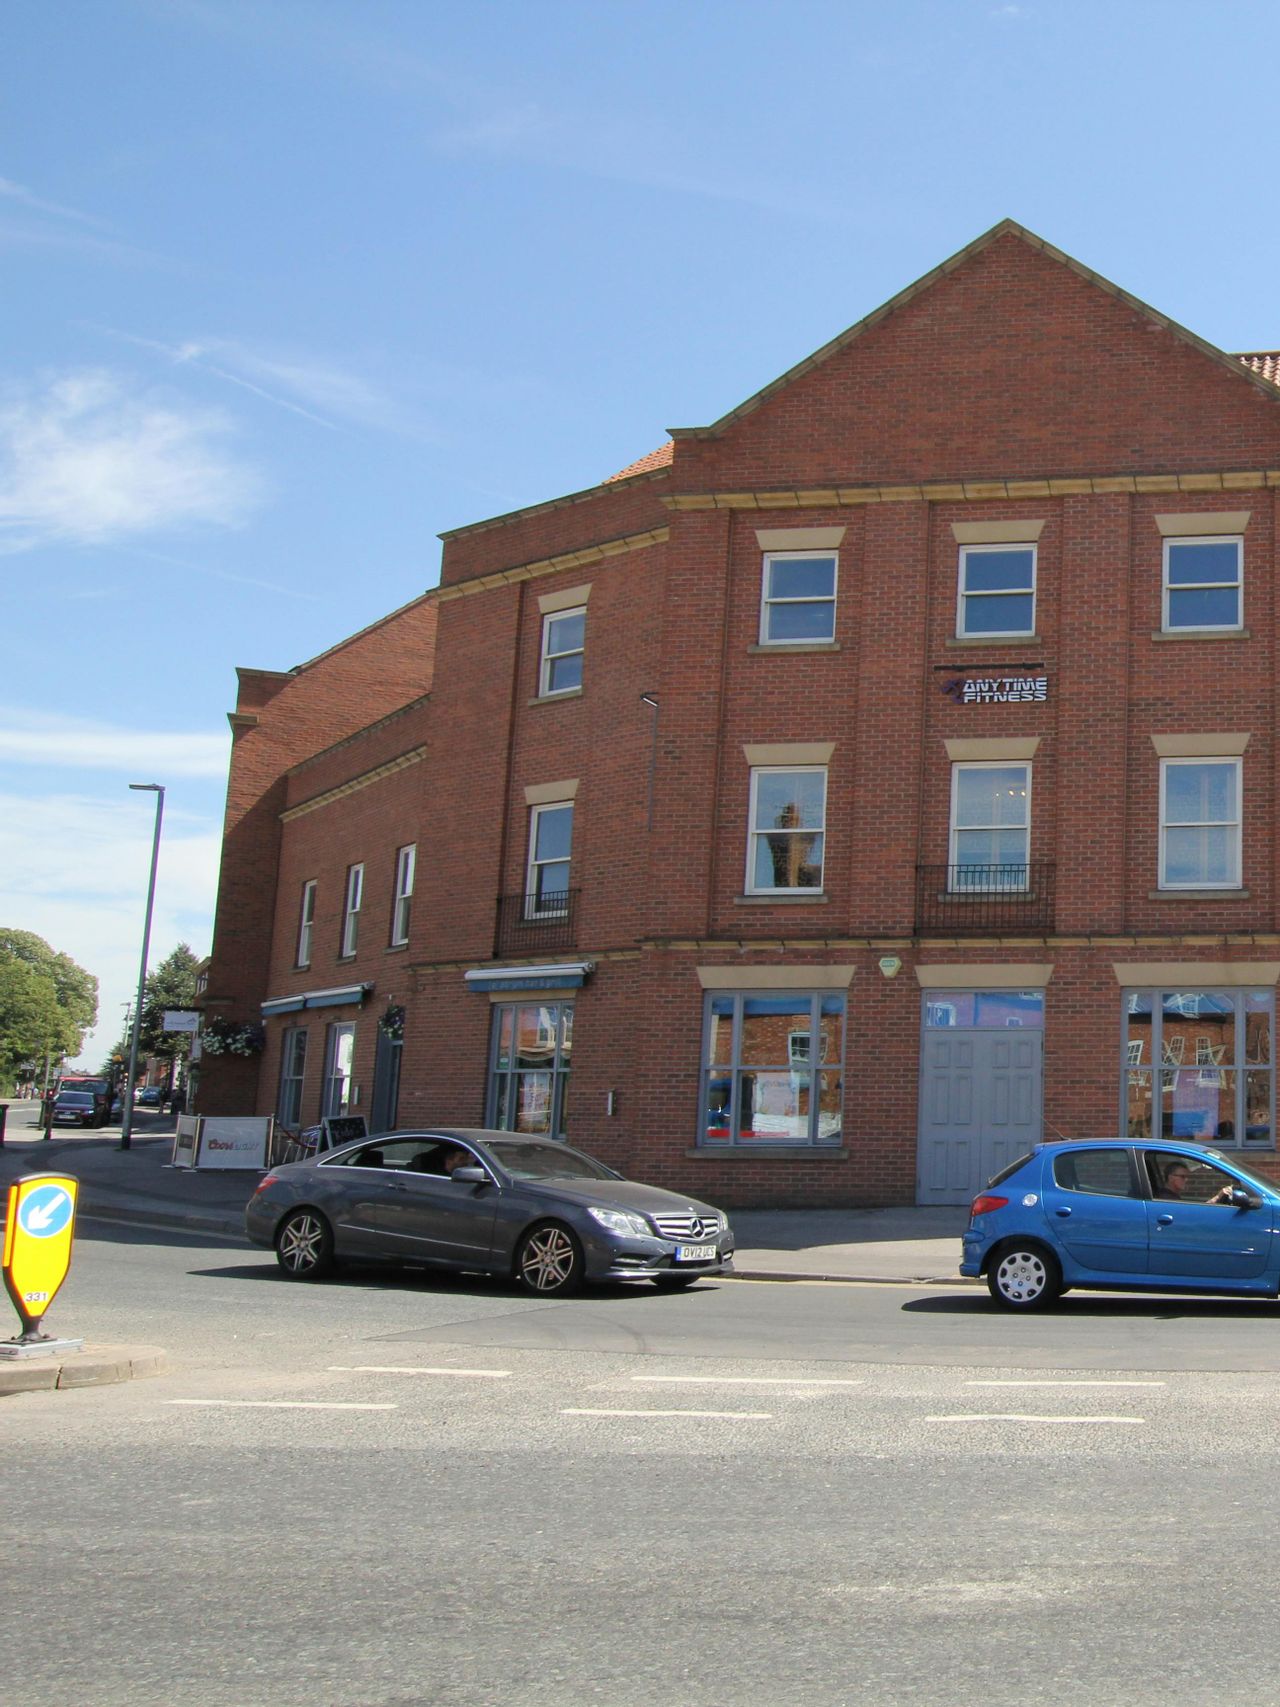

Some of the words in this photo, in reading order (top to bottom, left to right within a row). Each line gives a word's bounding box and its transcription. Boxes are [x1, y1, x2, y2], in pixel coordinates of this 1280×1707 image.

[962, 677, 1048, 692] ANYTIME
[963, 690, 1047, 703] FITNESS
[25, 1292, 48, 1302] 331
